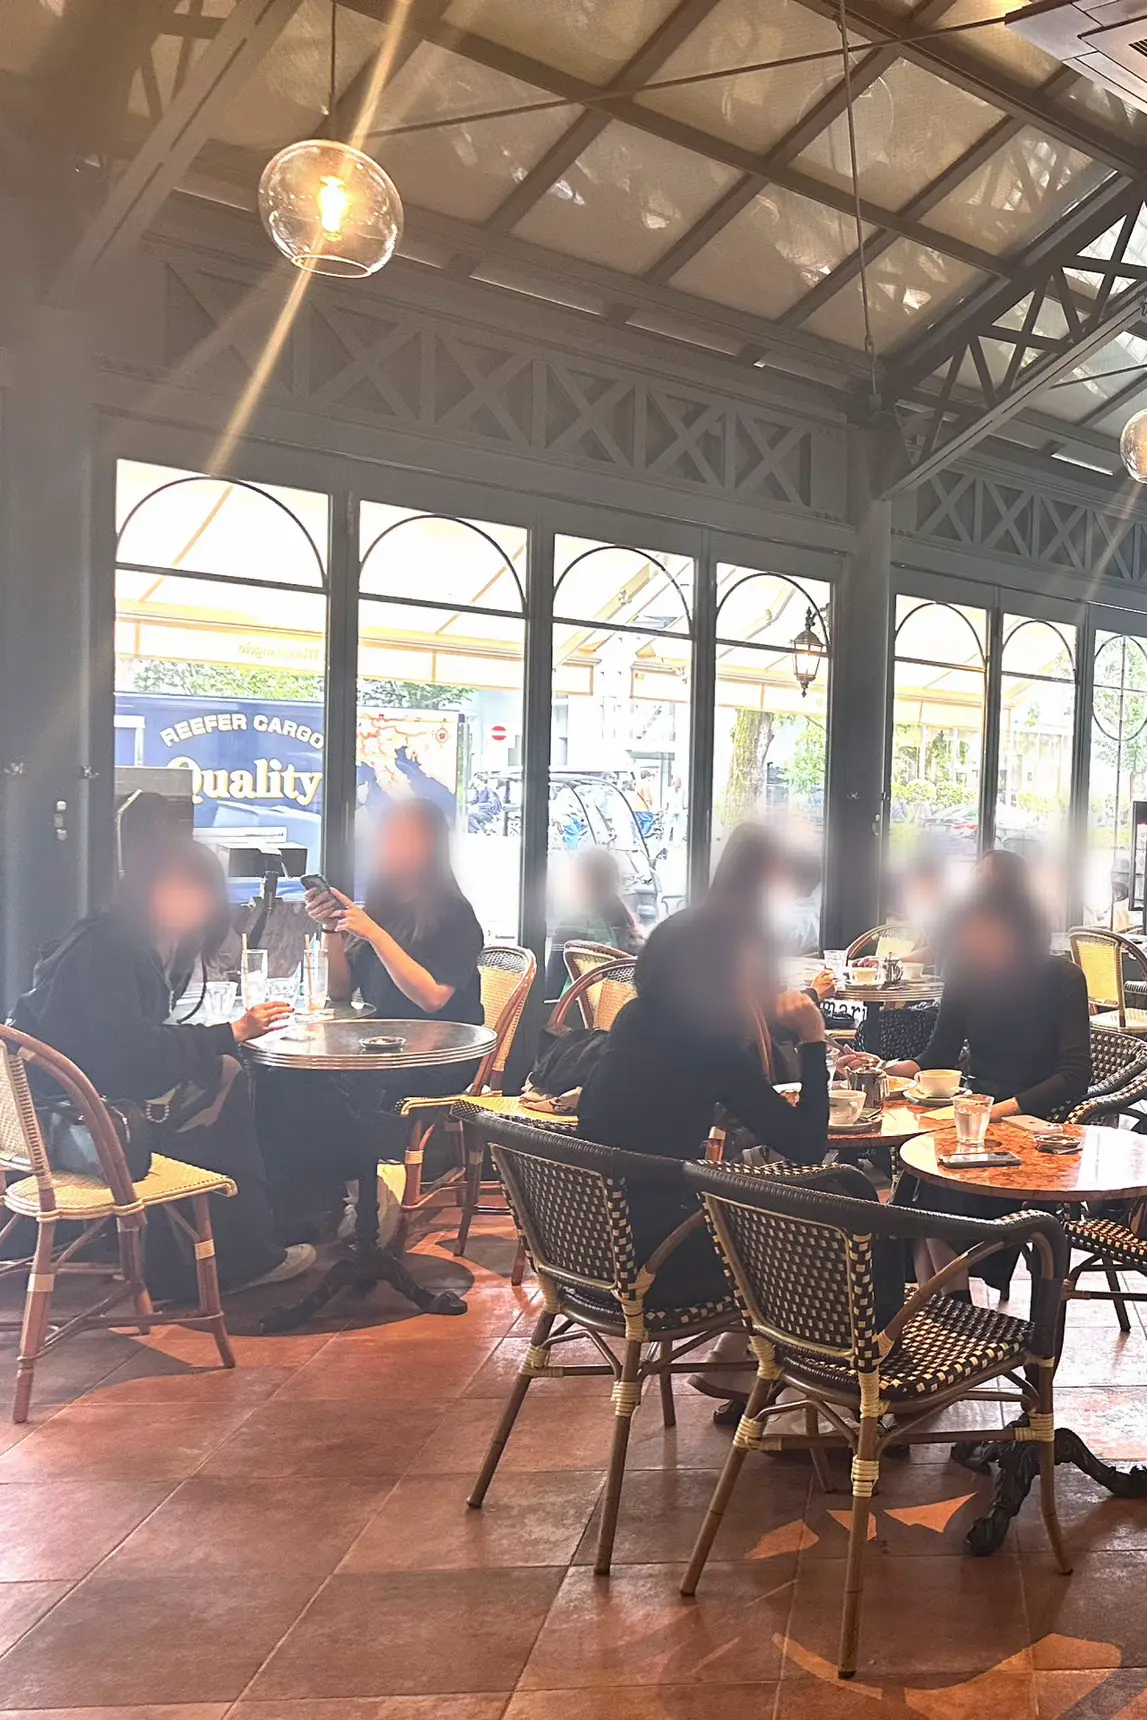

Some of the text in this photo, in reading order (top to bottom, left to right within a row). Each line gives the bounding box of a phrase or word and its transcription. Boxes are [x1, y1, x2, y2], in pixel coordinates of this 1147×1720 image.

[159, 713, 324, 749] REEFER CARGO
[167, 756, 323, 806] Quality
